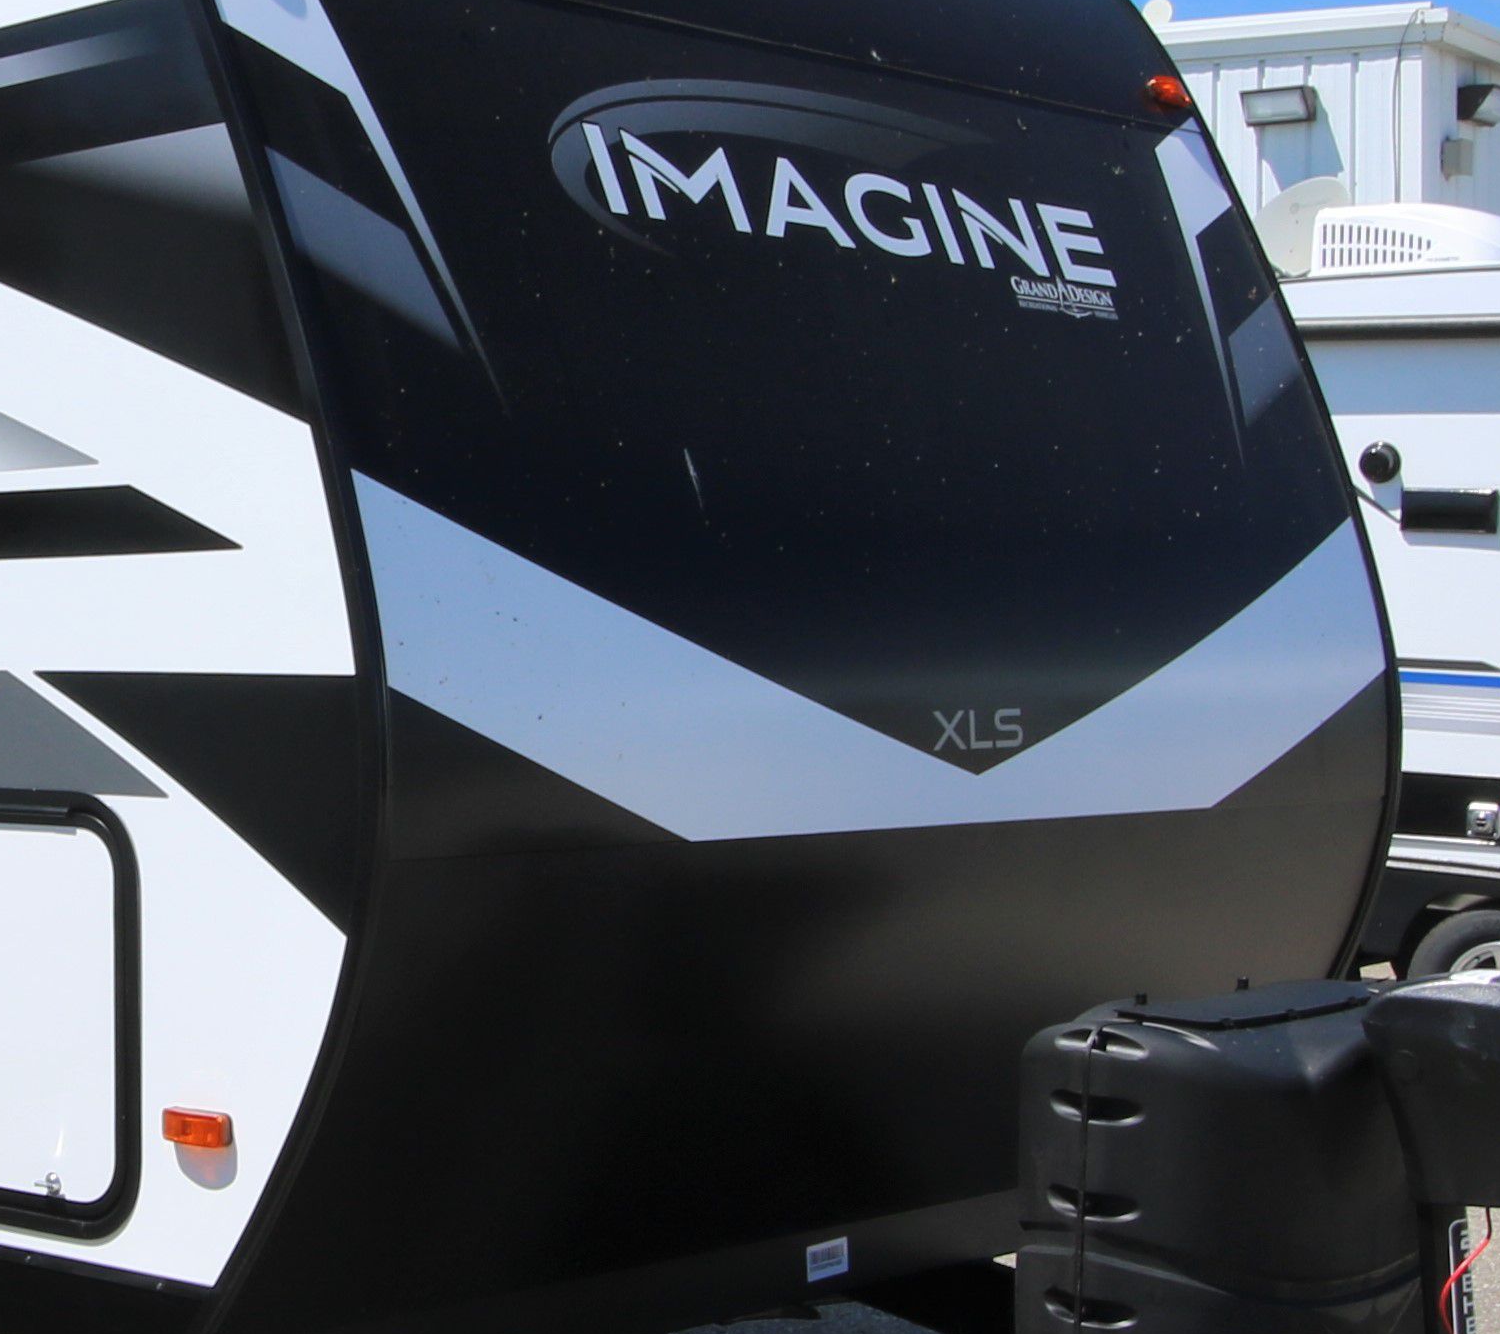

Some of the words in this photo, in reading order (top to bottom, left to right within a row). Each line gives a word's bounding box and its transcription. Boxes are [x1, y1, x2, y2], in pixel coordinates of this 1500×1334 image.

[582, 121, 1116, 286] IMAGINE
[1011, 276, 1058, 299] GRAND
[1067, 283, 1113, 306] DESIGN
[932, 708, 1024, 751] XLS
